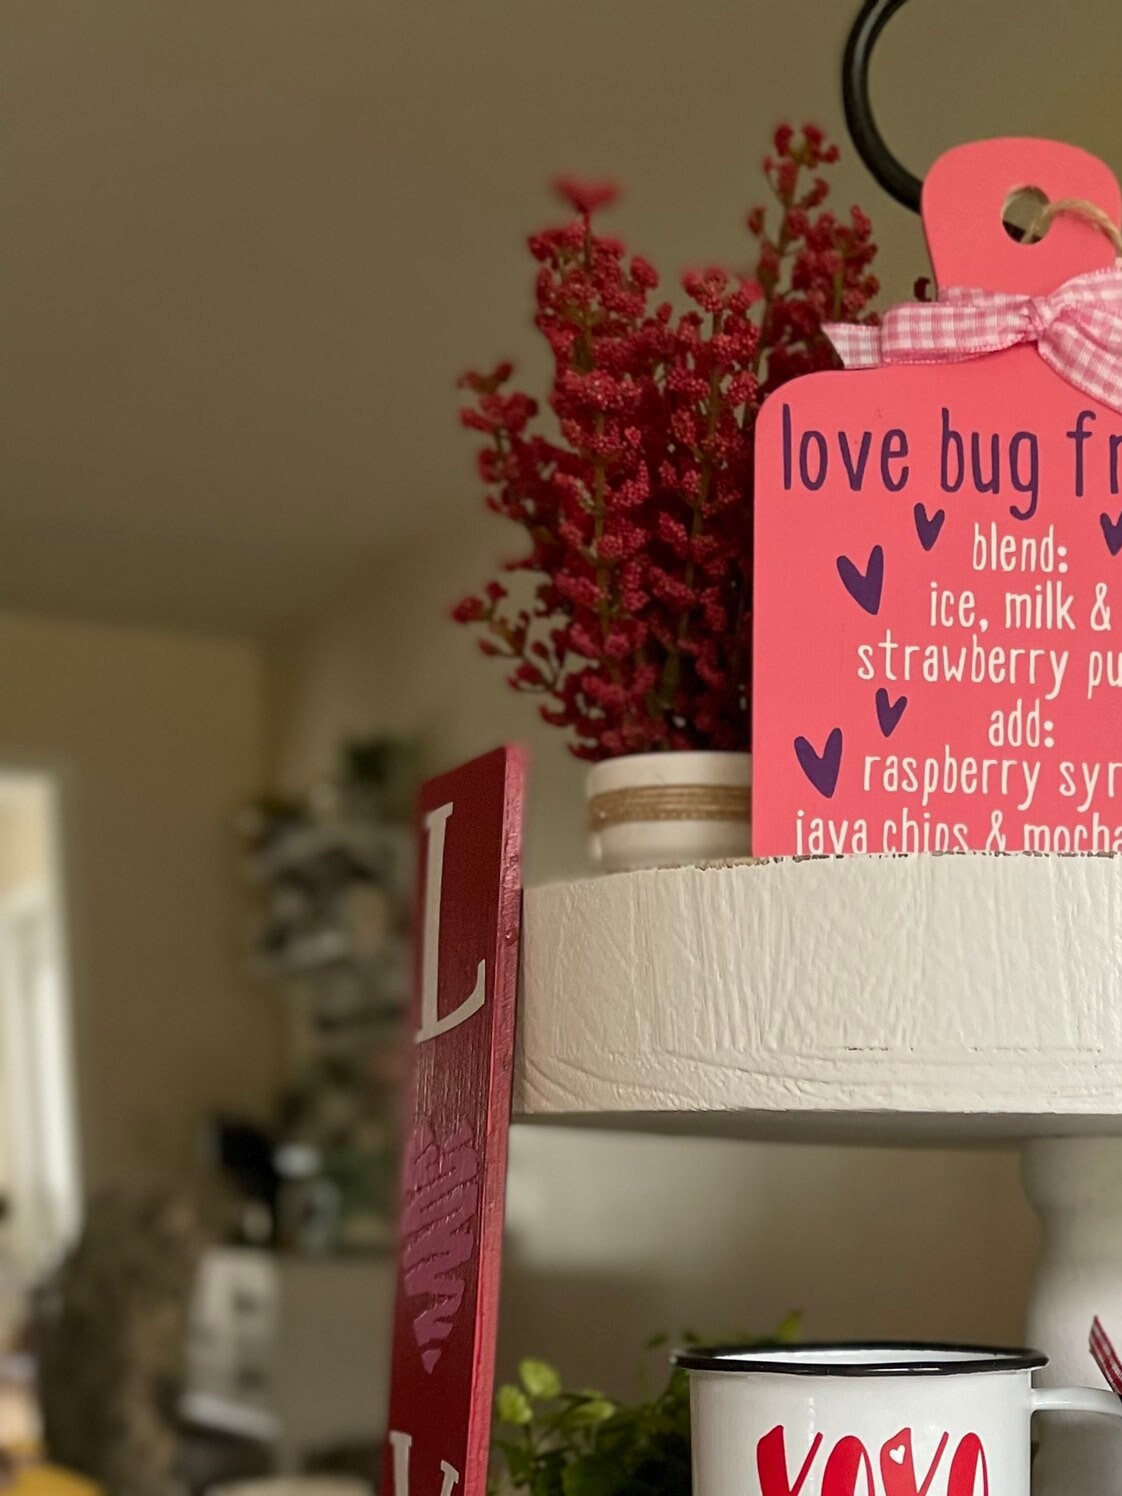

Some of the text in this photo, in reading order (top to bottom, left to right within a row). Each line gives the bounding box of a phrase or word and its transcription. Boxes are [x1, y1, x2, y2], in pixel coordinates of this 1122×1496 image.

[782, 402, 910, 492] love
[939, 407, 1040, 521] bug
[971, 521, 1069, 574] blend:
[929, 580, 1112, 632] ice, milk &
[857, 629, 1069, 700] strawberry
[988, 698, 1055, 748] add:
[863, 745, 1041, 810] raspberry
[795, 809, 868, 855] java
[882, 807, 970, 854] chips
[985, 809, 1007, 853] &
